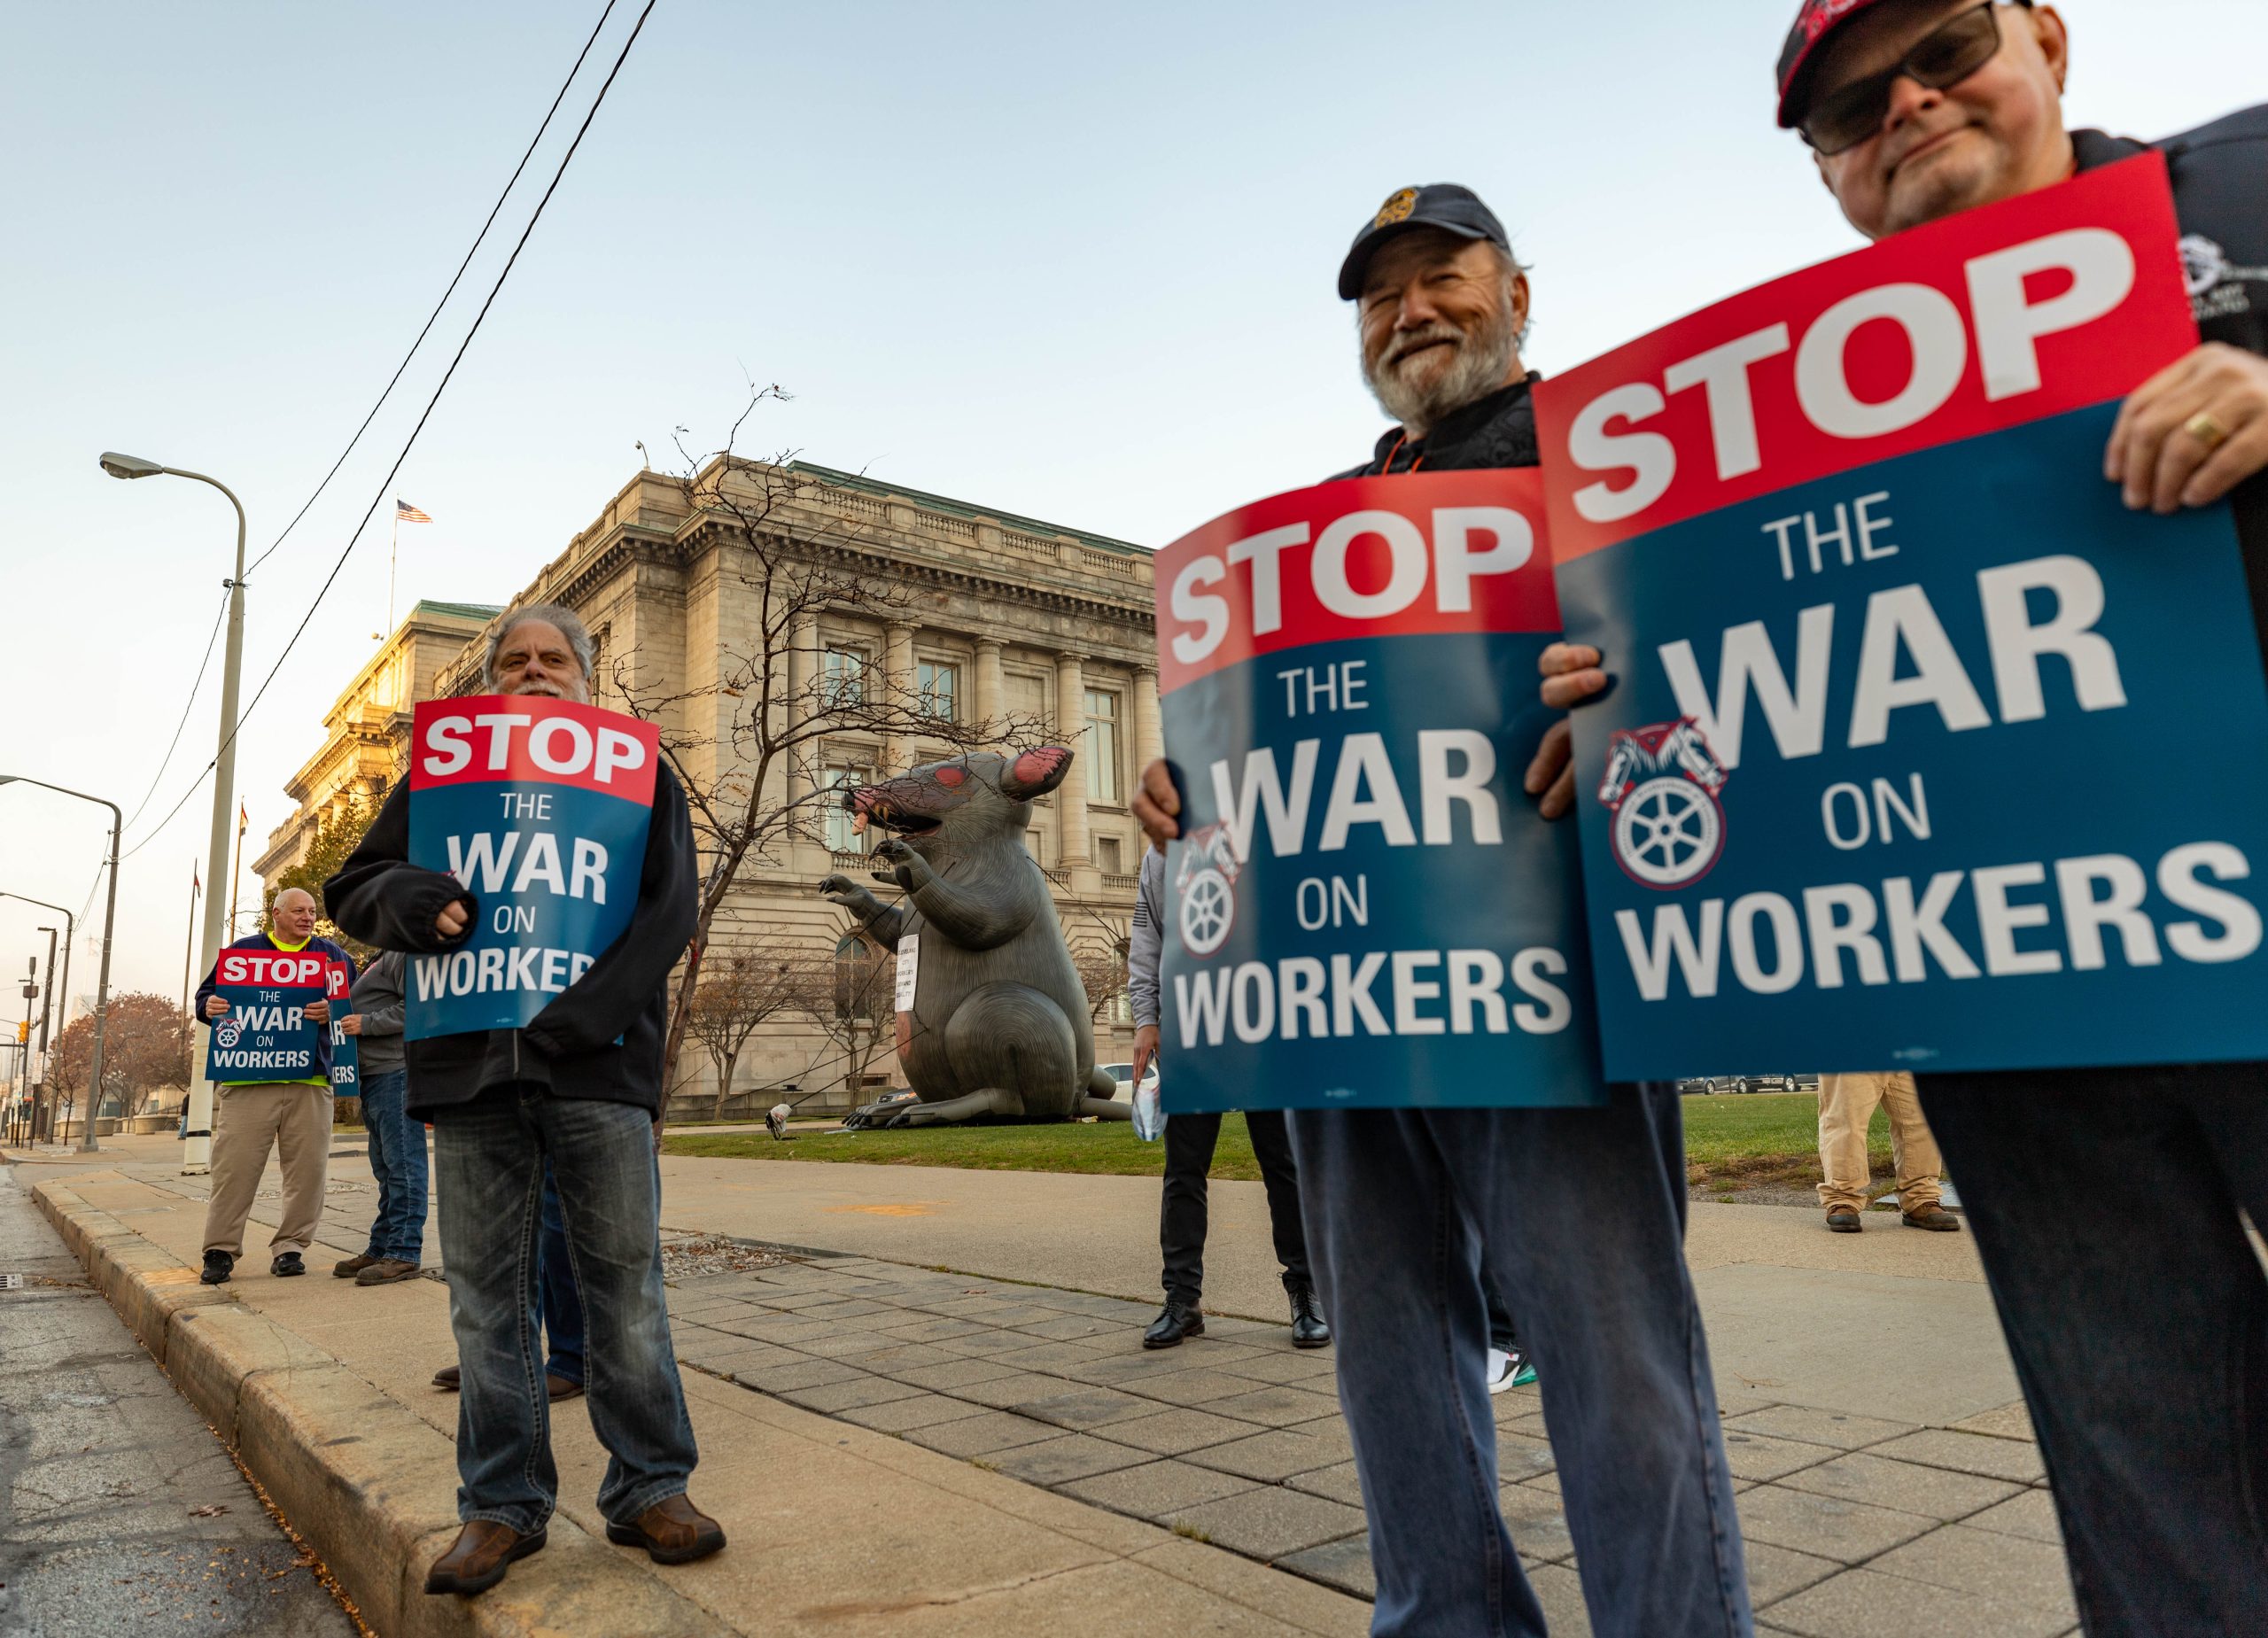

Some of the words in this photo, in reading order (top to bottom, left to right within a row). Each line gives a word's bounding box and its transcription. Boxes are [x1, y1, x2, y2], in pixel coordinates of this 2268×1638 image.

[1568, 229, 2135, 523] STOP
[1763, 492, 1898, 579] THE
[1169, 507, 1534, 665] STOP
[1277, 660, 1369, 718] THE
[1659, 555, 2127, 769] WAR
[423, 713, 646, 784] STOP
[500, 792, 553, 820] THE
[1210, 728, 1503, 863] WAR
[1822, 773, 1931, 850] ON
[446, 831, 610, 905] WAR
[493, 905, 536, 934] ON
[1296, 874, 1369, 931] ON
[1615, 842, 2264, 1000] WORKERS
[223, 956, 321, 983] STOP
[259, 990, 281, 1003] THE
[326, 970, 345, 997] OP
[415, 946, 596, 1002] WORKER
[1174, 947, 1572, 1049] WORKERS
[235, 1005, 304, 1032] WAR
[256, 1035, 274, 1048] ON
[329, 1020, 346, 1046] AR
[214, 1050, 310, 1068] WORKERS
